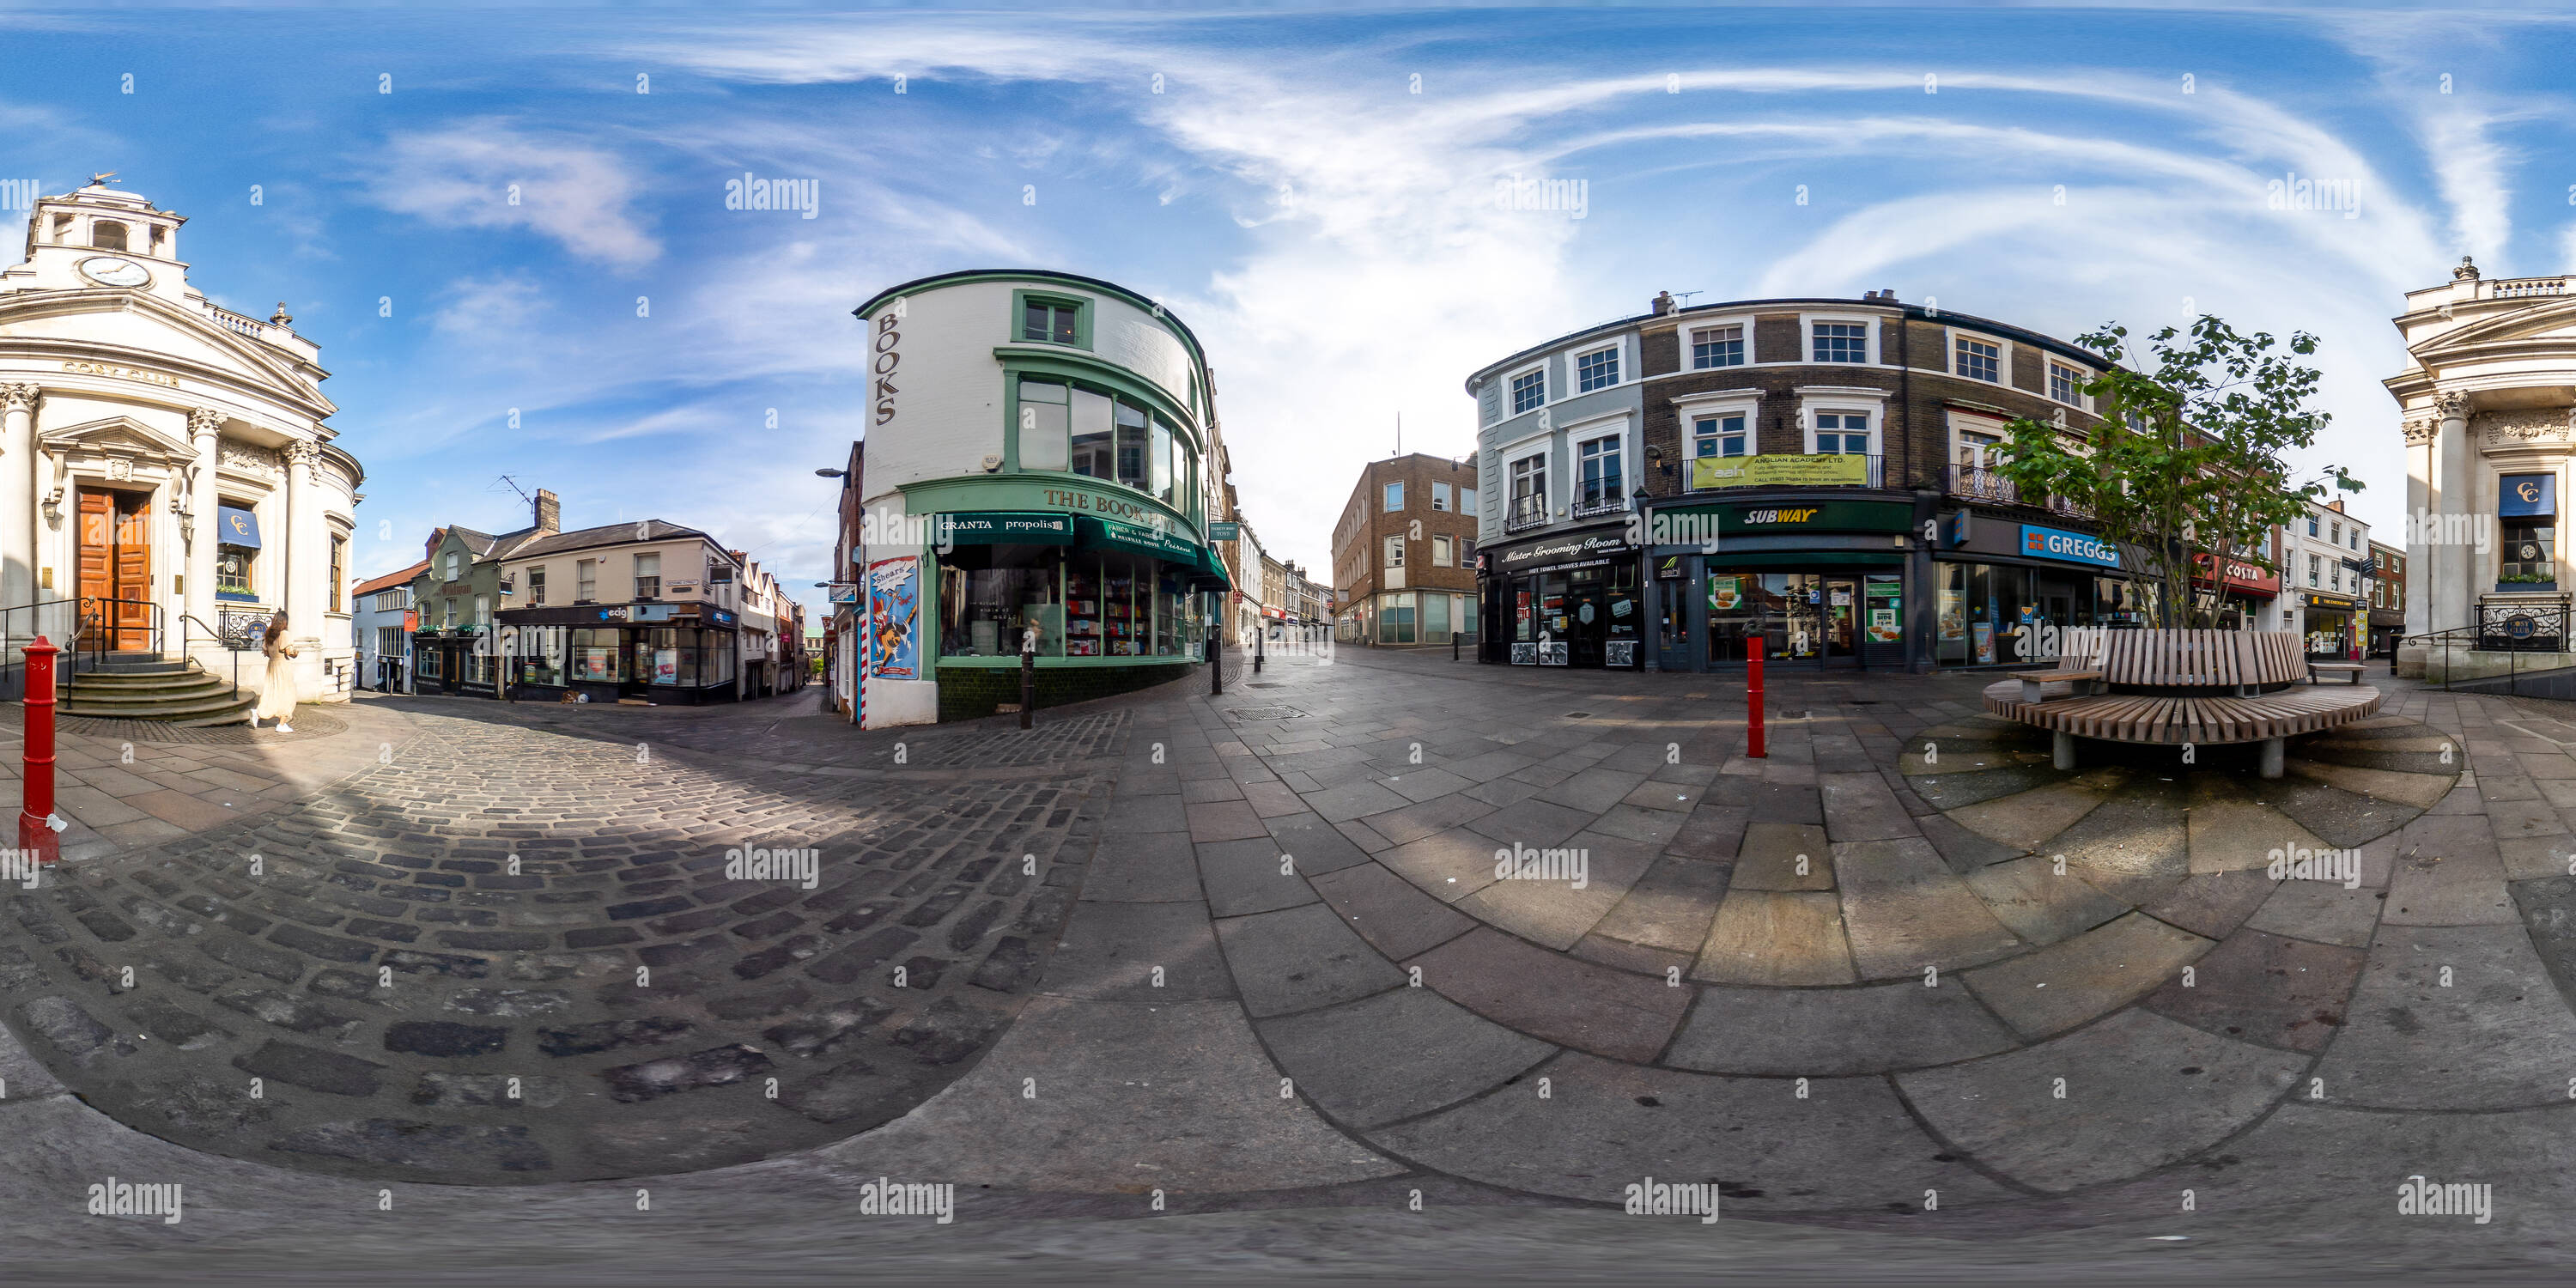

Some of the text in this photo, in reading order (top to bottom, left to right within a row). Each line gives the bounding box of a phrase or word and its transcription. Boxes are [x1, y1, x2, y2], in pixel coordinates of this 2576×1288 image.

[62, 361, 179, 387] COSY CLUB
[875, 313, 901, 426] BOOKS
[1044, 489, 1090, 510] THE
[1096, 495, 1145, 523] BOOK
[1744, 509, 1817, 525] SUBWAY
[940, 520, 993, 531] GRANTA
[1108, 525, 1130, 534] FABER
[1164, 539, 1191, 554] Peirene
[1502, 537, 1622, 563] Mister Grooming Room
[2048, 535, 2116, 562] GREGGS
[1540, 565, 1558, 574] TOWEL
[1579, 558, 1610, 568] AVAILABLE
[2227, 564, 2258, 580] COSTA
[877, 568, 904, 584] Shears
[608, 607, 627, 618] ecig
